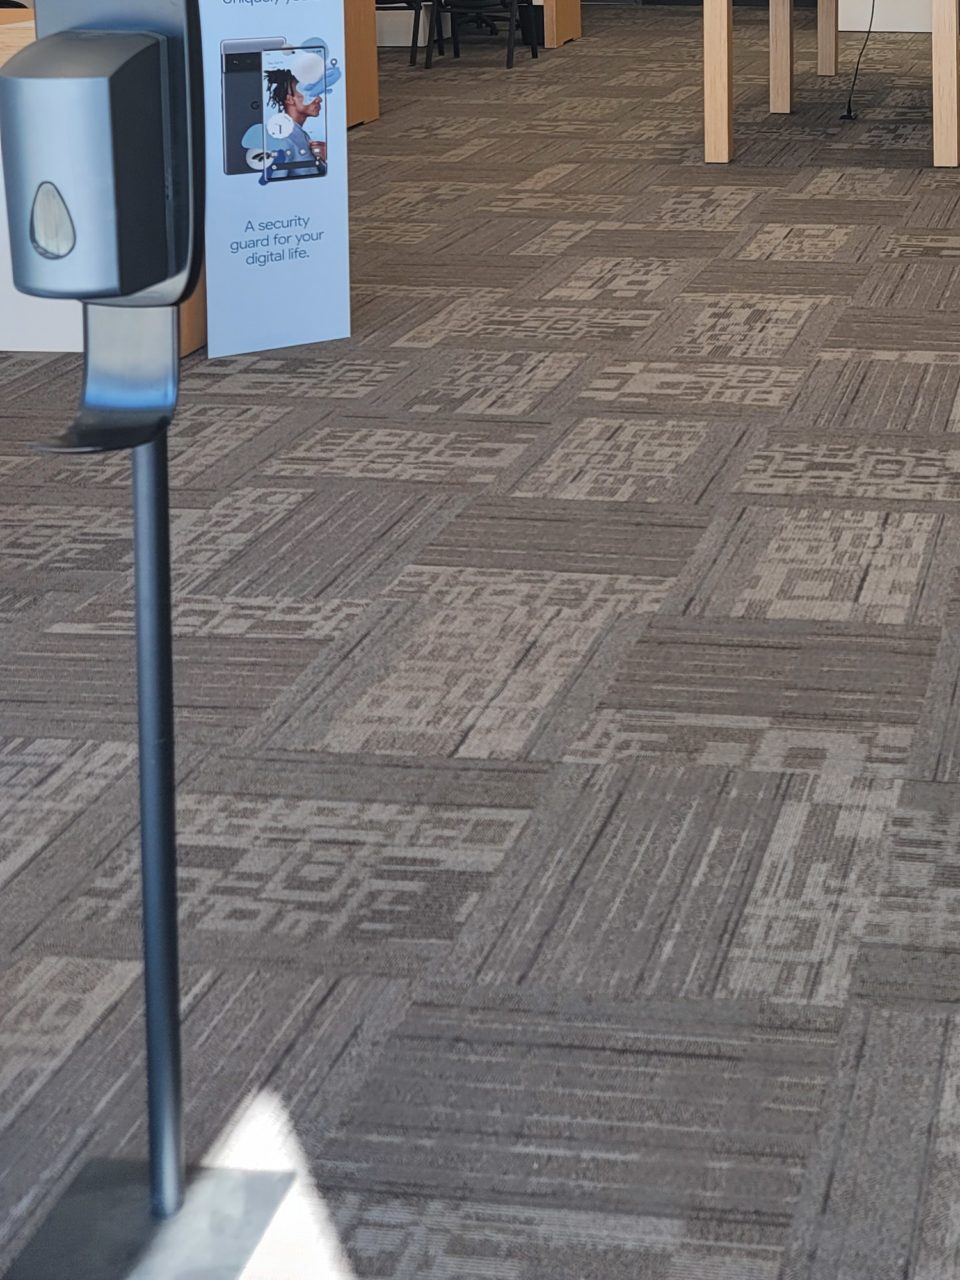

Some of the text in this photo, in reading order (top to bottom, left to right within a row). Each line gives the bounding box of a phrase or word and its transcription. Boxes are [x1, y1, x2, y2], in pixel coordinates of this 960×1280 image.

[244, 216, 310, 233] A security
[229, 231, 325, 254] guard for your
[245, 247, 310, 267] digital life.
